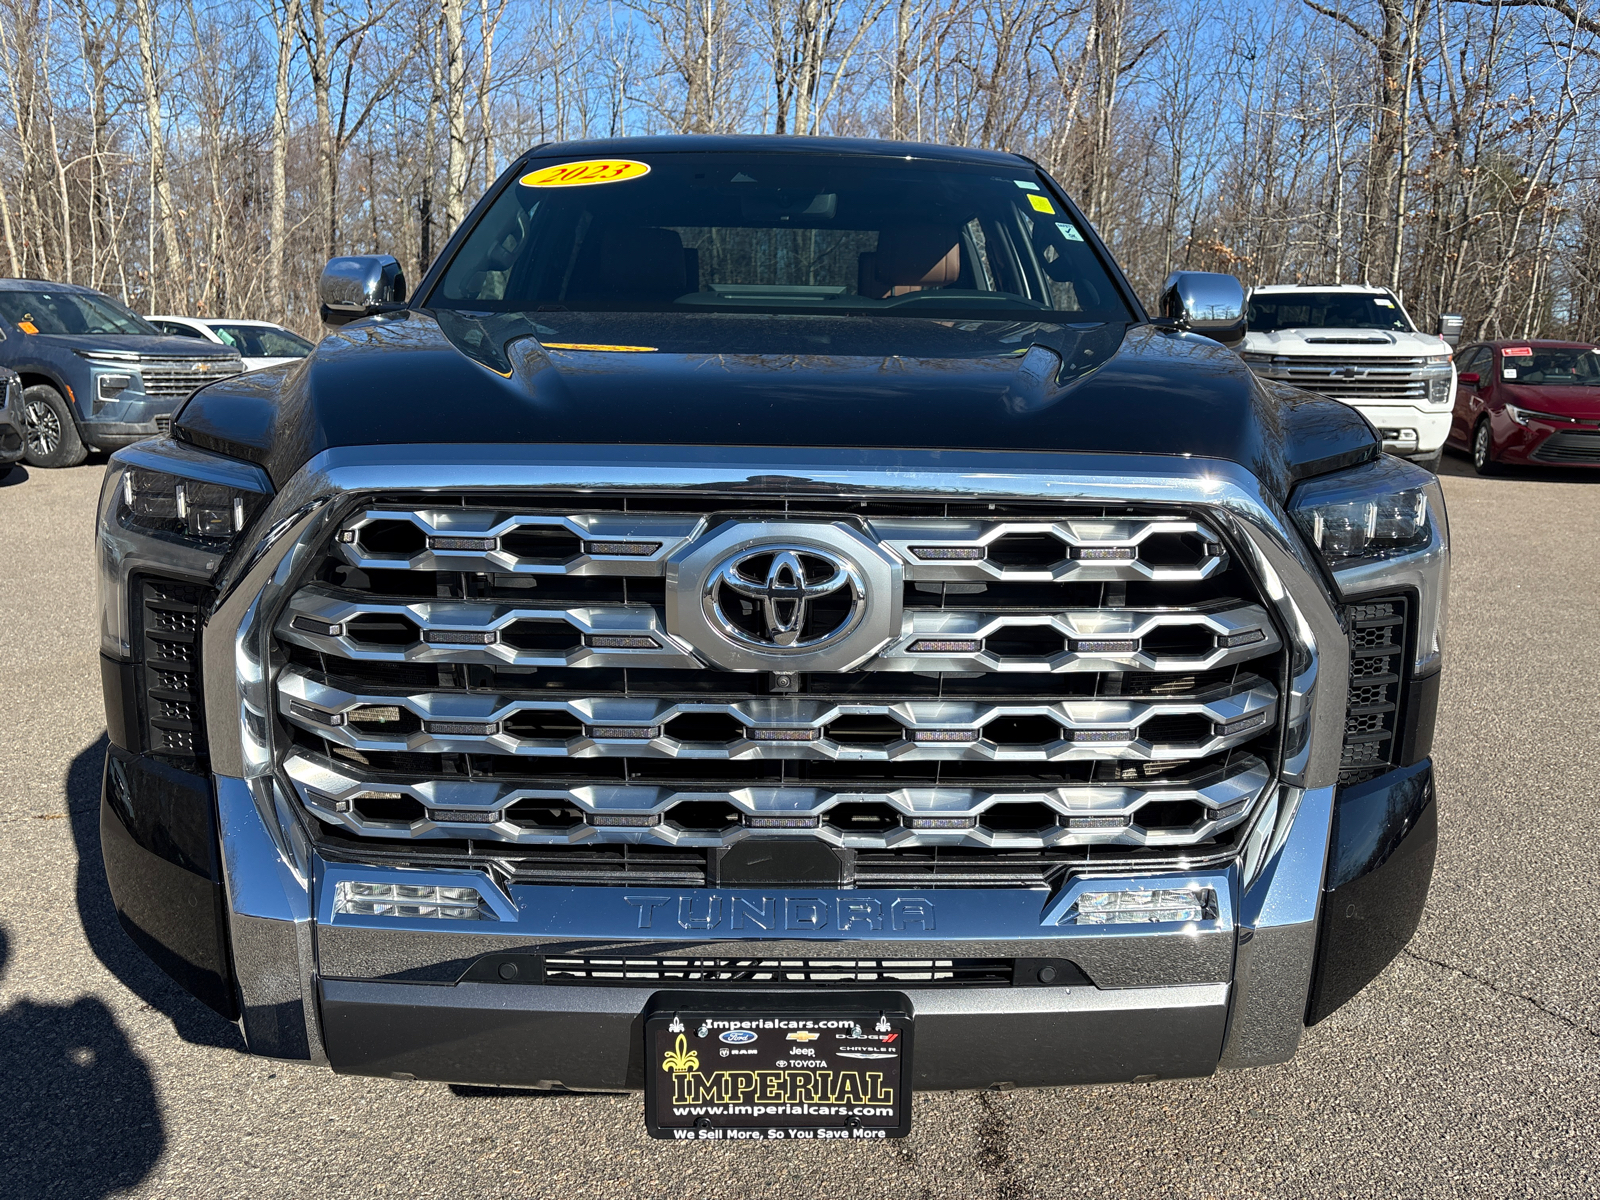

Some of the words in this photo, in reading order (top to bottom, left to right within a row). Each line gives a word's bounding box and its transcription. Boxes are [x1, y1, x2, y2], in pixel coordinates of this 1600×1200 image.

[536, 164, 631, 184] 2023
[623, 895, 936, 931] TUNDRA
[705, 1018, 855, 1031] Imperialcars.com
[788, 1046, 816, 1057] Jeep
[789, 1060, 828, 1068] TOYOTA
[672, 1070, 894, 1106] IMPERIAL
[672, 1103, 894, 1117] www.imperialcars.com
[673, 1129, 695, 1140] We
[698, 1129, 723, 1140] Sell
[727, 1129, 764, 1141] More,
[767, 1128, 785, 1139] So
[788, 1128, 814, 1139] You
[817, 1128, 849, 1139] Save
[852, 1128, 886, 1139] More
